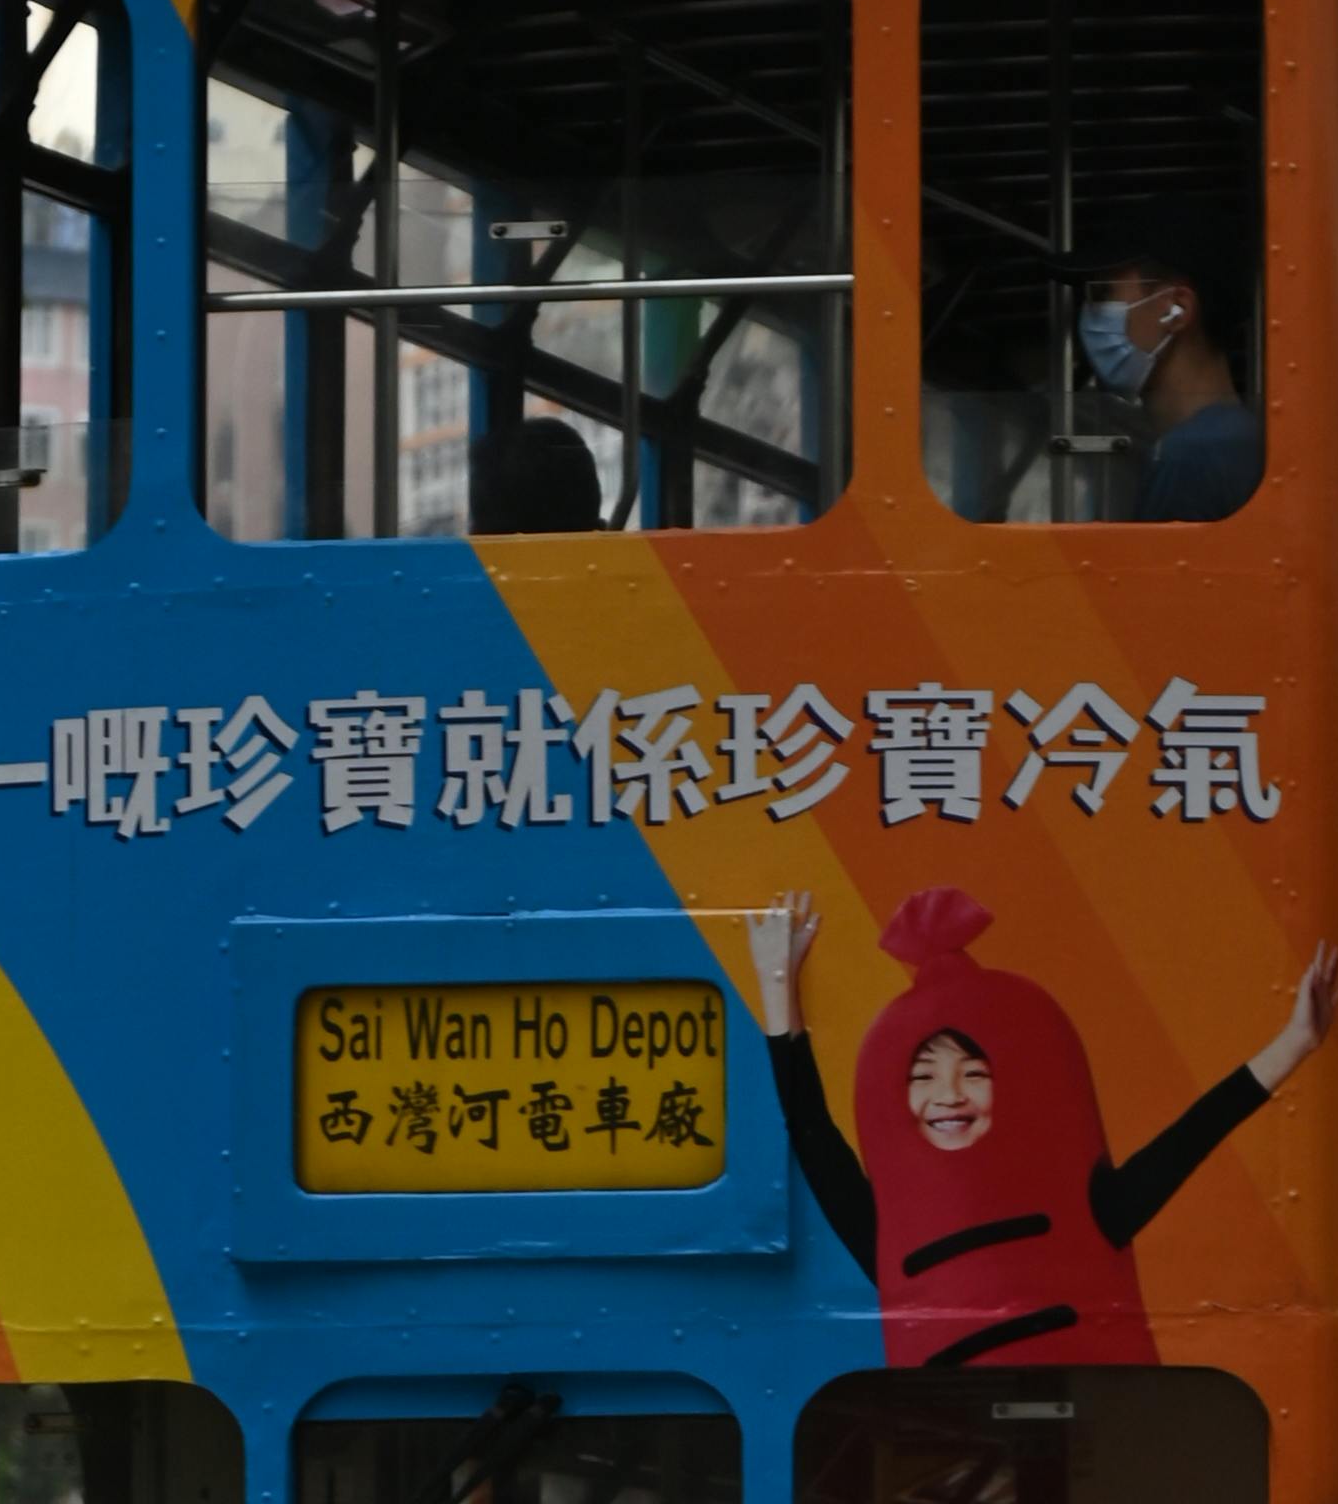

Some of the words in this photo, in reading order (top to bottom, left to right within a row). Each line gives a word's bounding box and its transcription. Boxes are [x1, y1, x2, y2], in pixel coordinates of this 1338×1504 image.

[319, 996, 383, 1062] Sai
[404, 996, 492, 1061] Wan
[514, 995, 569, 1060] Ho
[590, 994, 719, 1070] Depot
[318, 1076, 717, 1156] 西灣河電車廠
